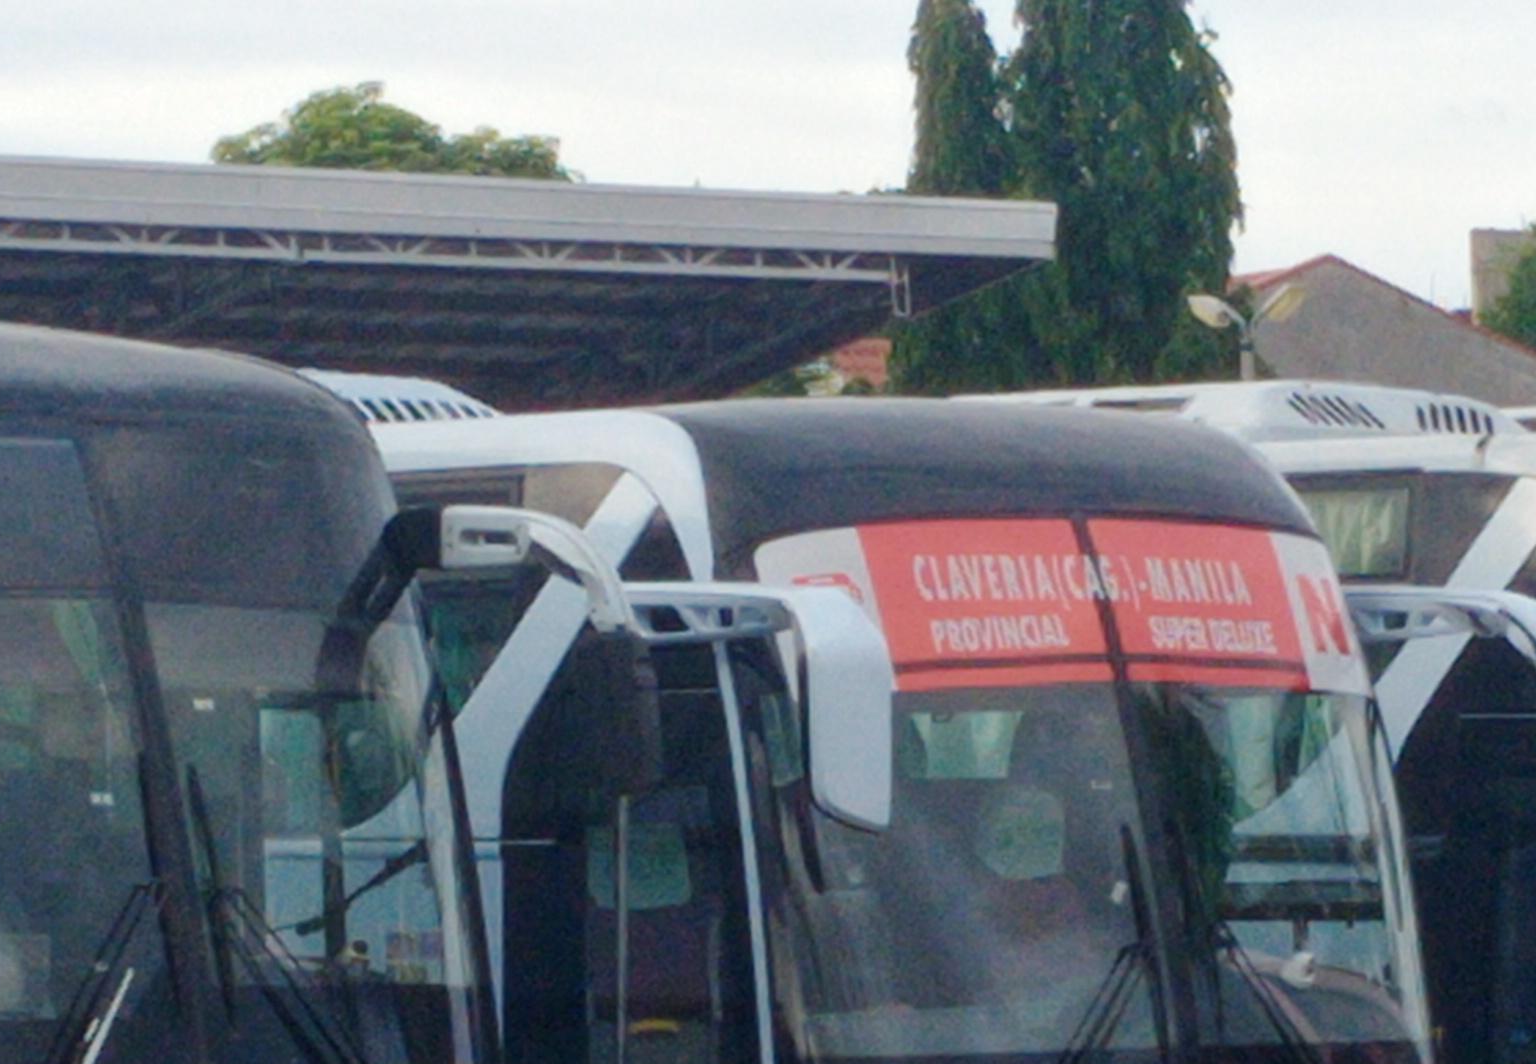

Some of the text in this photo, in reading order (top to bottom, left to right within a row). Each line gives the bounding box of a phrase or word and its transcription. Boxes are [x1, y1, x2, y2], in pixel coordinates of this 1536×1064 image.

[931, 615, 1070, 654] PROVINCIAL
[1149, 616, 1277, 654] SUPER DELUXE
